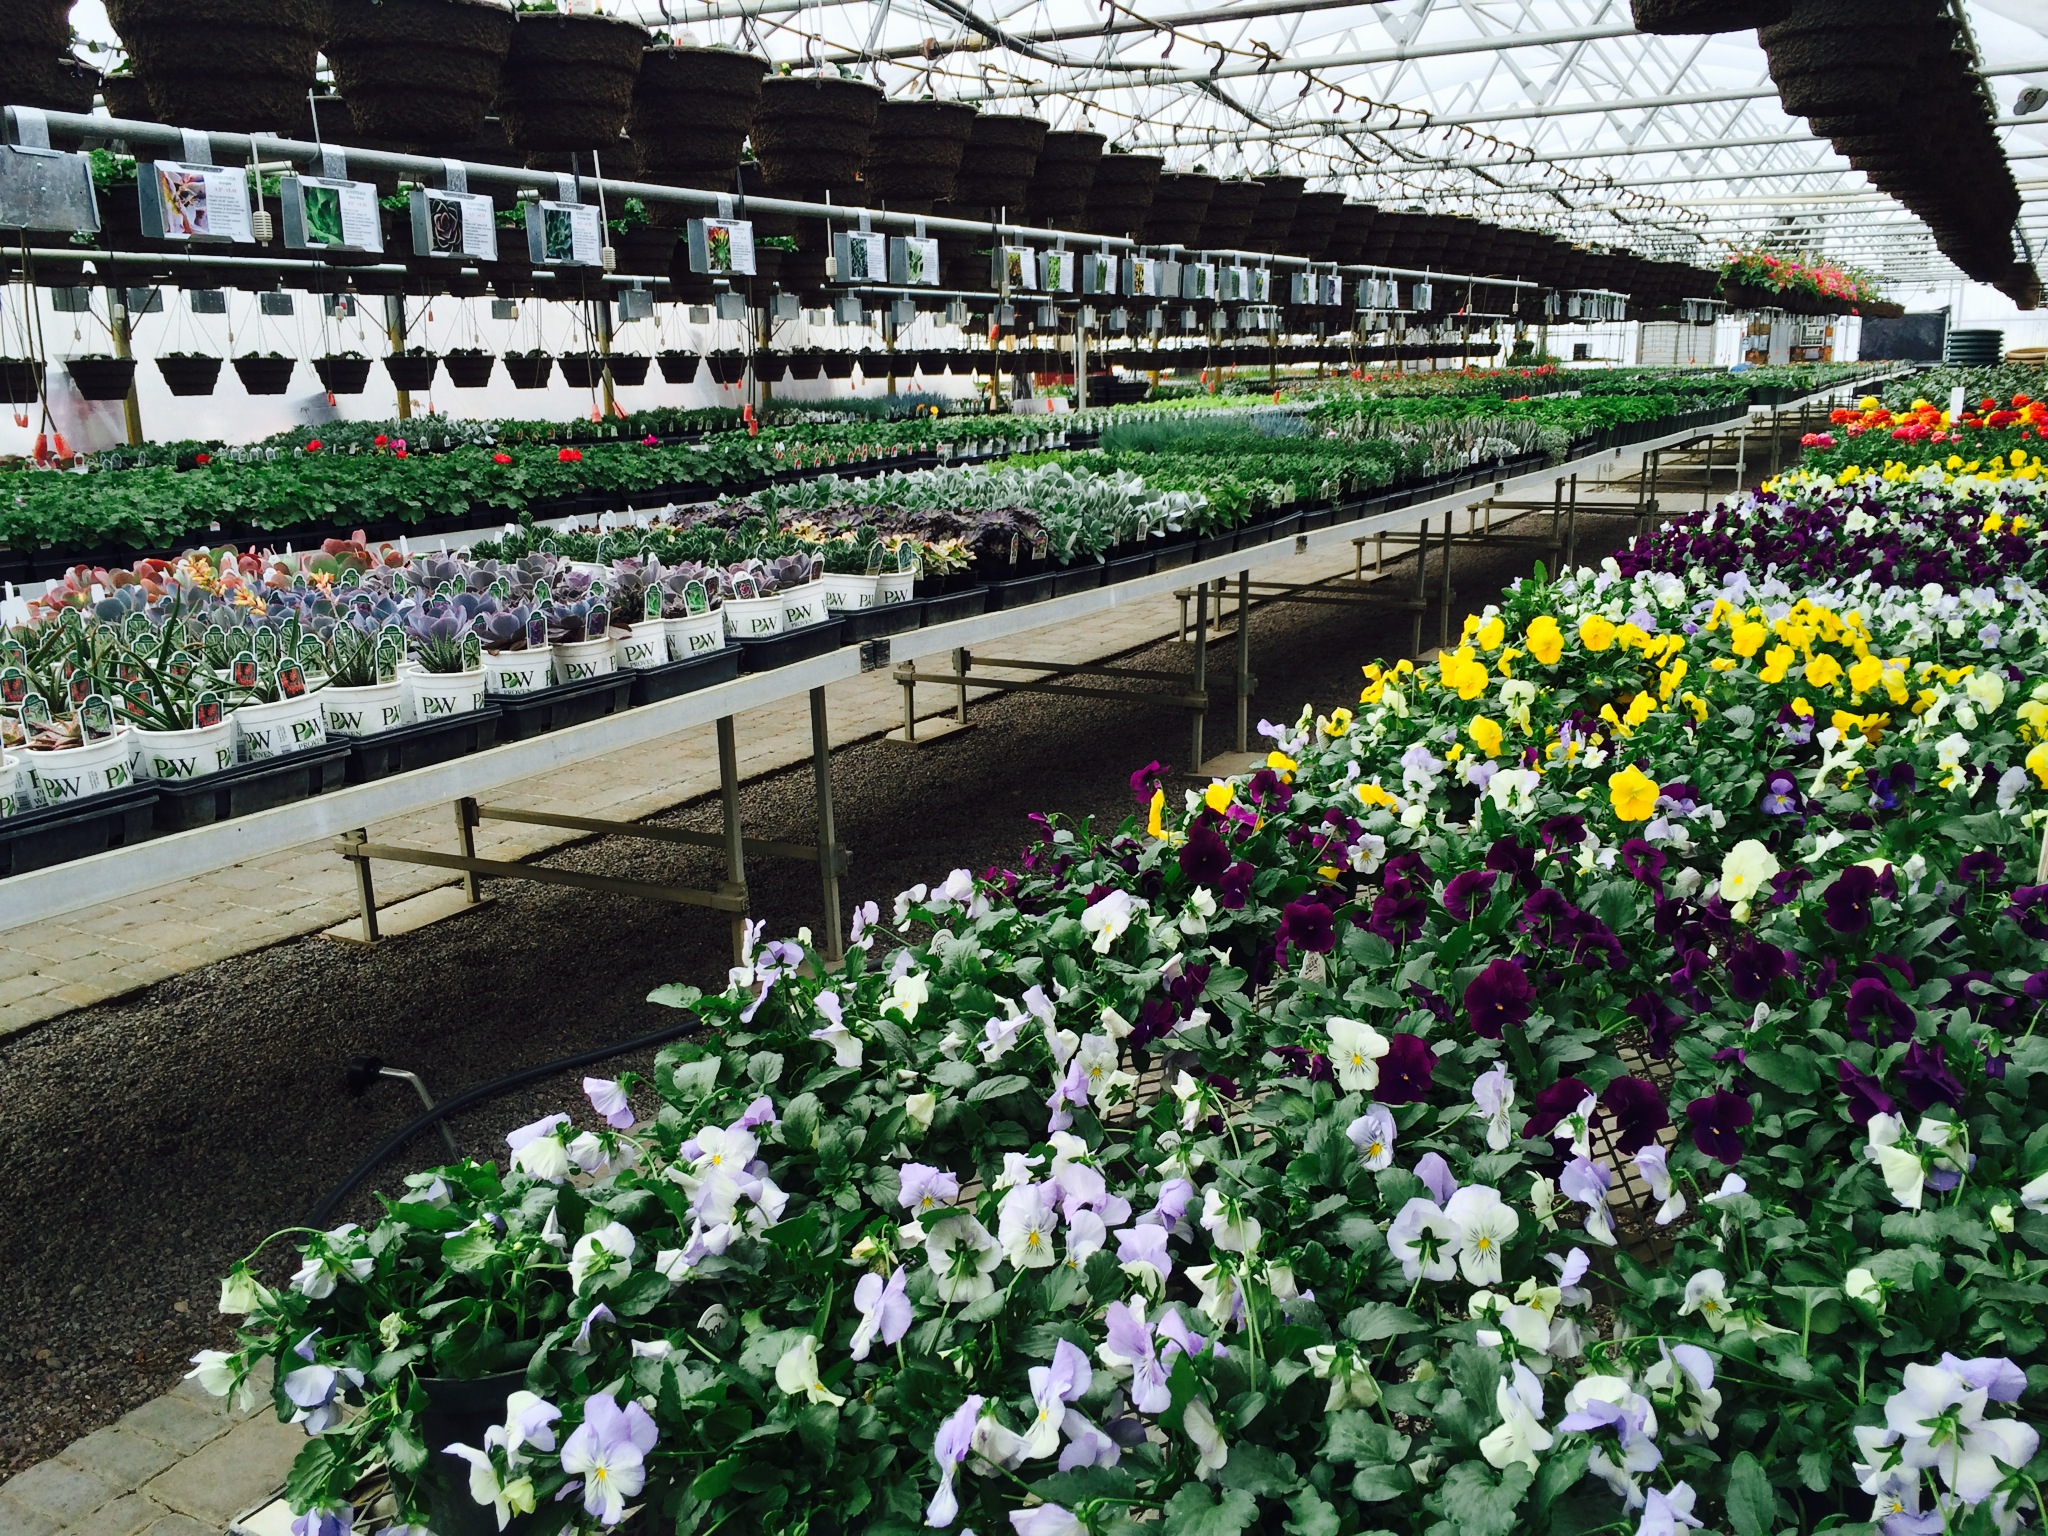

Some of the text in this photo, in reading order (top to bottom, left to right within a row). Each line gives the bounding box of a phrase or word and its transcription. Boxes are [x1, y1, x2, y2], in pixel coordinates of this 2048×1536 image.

[825, 592, 847, 606] PW
[883, 589, 908, 604] PW
[785, 603, 812, 623] PW
[752, 616, 778, 633] PW
[688, 630, 716, 651] PW
[625, 641, 654, 662] PW
[500, 670, 534, 689] PW
[565, 662, 597, 679] PW
[422, 696, 457, 714] PW
[290, 716, 321, 743] PW
[329, 711, 363, 730] PW
[244, 730, 271, 750] PW
[153, 756, 197, 778] PW
[42, 776, 81, 798] PW
